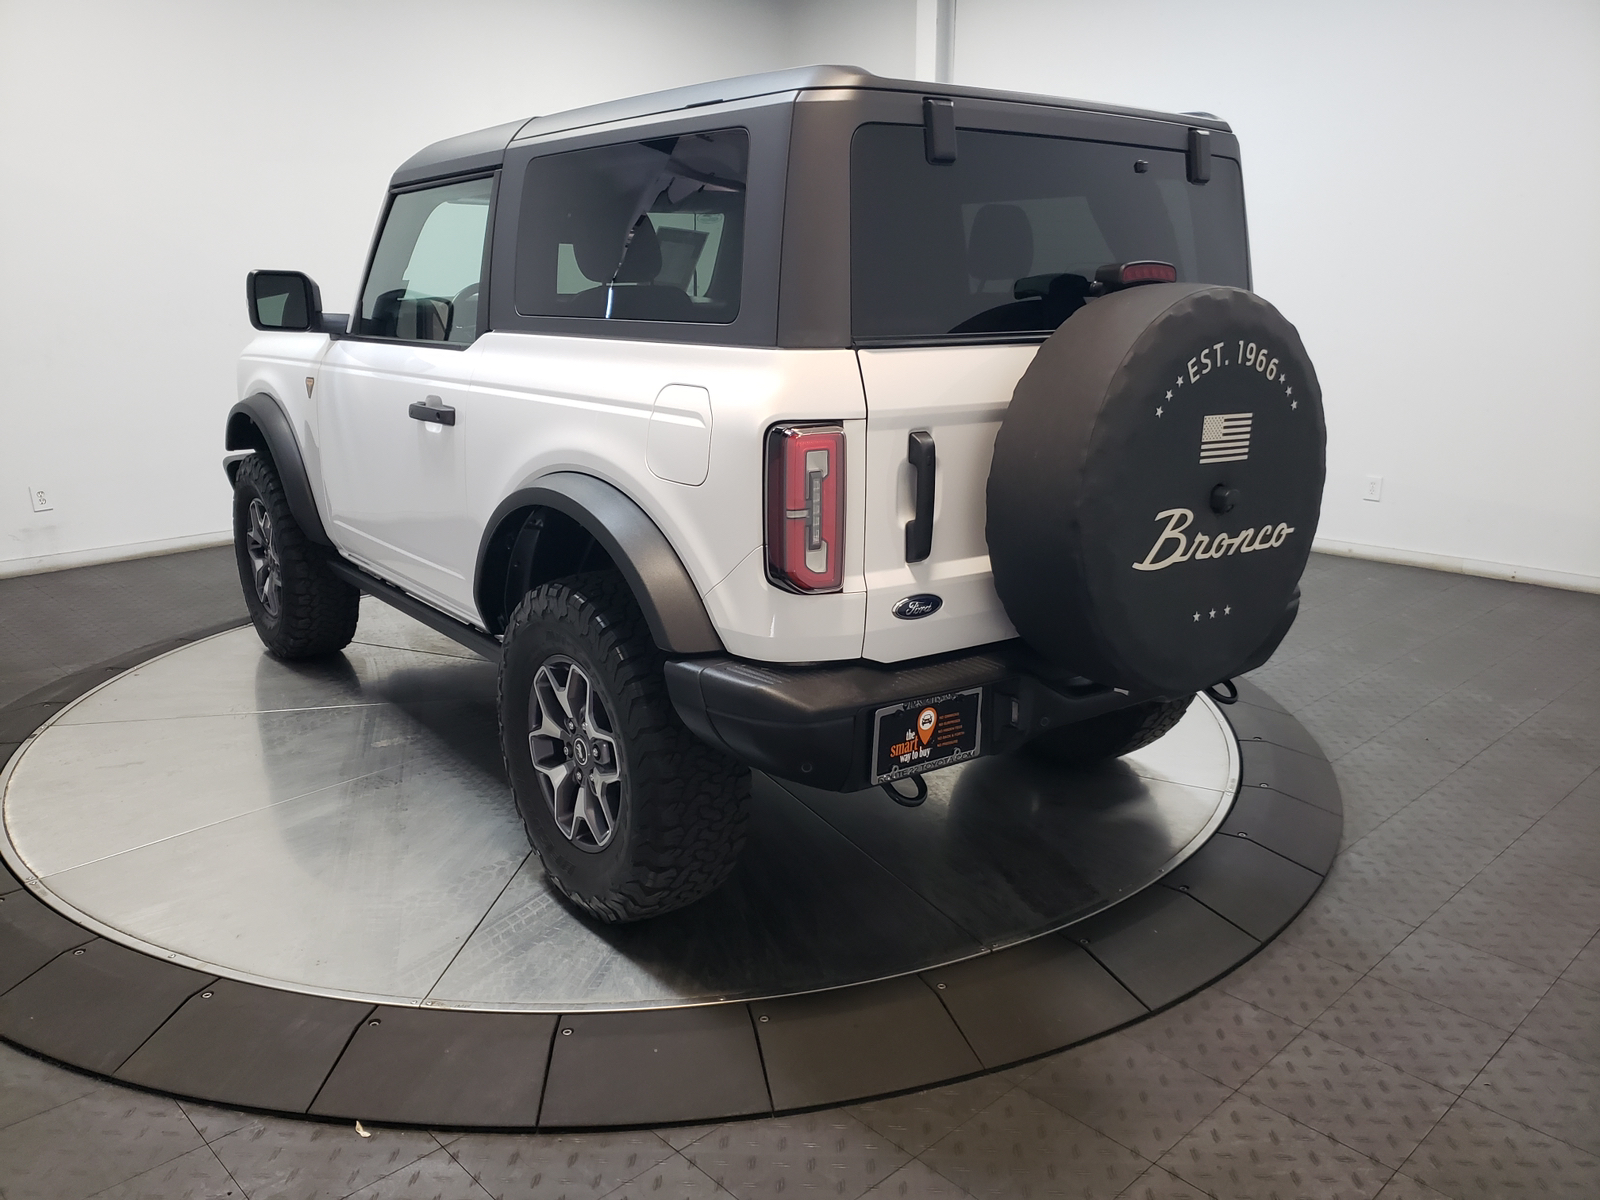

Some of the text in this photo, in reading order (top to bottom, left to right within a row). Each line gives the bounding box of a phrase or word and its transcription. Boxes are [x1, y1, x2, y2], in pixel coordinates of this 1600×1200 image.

[1187, 340, 1279, 384] EST. 1966
[1131, 508, 1295, 571] Bronco
[905, 601, 933, 615] Ford
[905, 728, 916, 741] the
[890, 735, 919, 758] smart
[900, 745, 931, 764] way to buy
